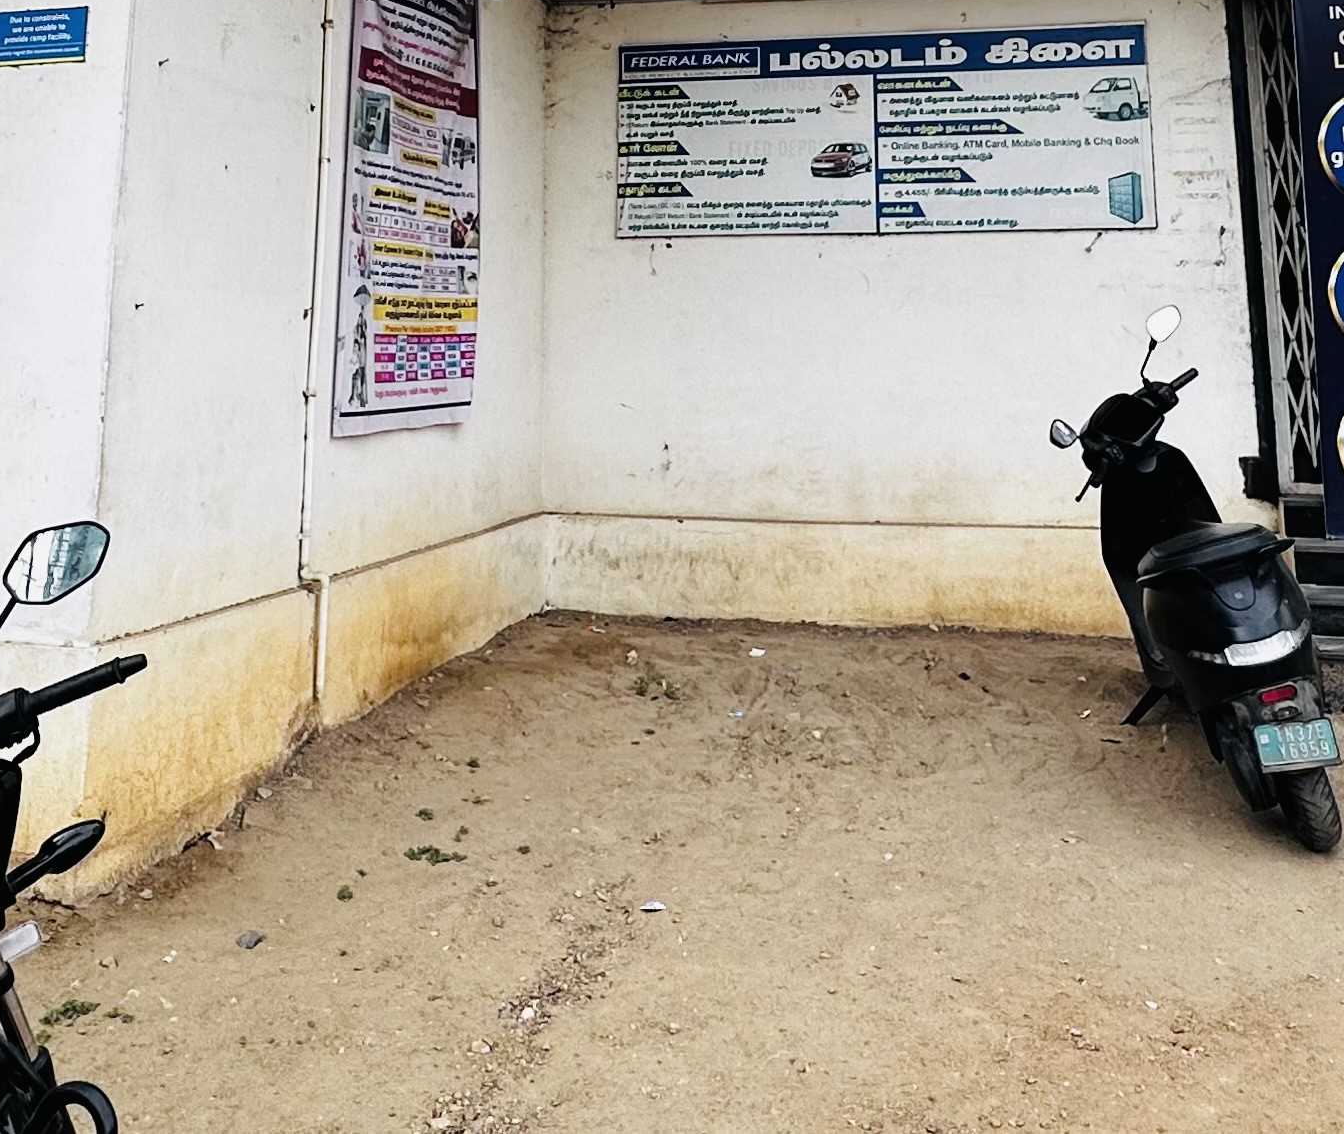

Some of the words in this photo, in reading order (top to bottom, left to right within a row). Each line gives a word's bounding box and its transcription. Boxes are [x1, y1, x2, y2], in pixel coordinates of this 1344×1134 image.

[10, 16, 22, 24] Due
[630, 54, 698, 68] FEDERAL
[703, 52, 751, 65] BANK
[770, 38, 967, 72] பல்லடம்
[985, 36, 1136, 64] கிளை
[891, 141, 920, 150] Online
[963, 140, 983, 148] ATM
[985, 139, 1008, 148] Card,
[1012, 139, 1041, 147] Mobile
[1044, 137, 1082, 148] Banking
[1084, 138, 1090, 146] &
[1094, 137, 1112, 147] Chq
[1116, 136, 1139, 145] Book
